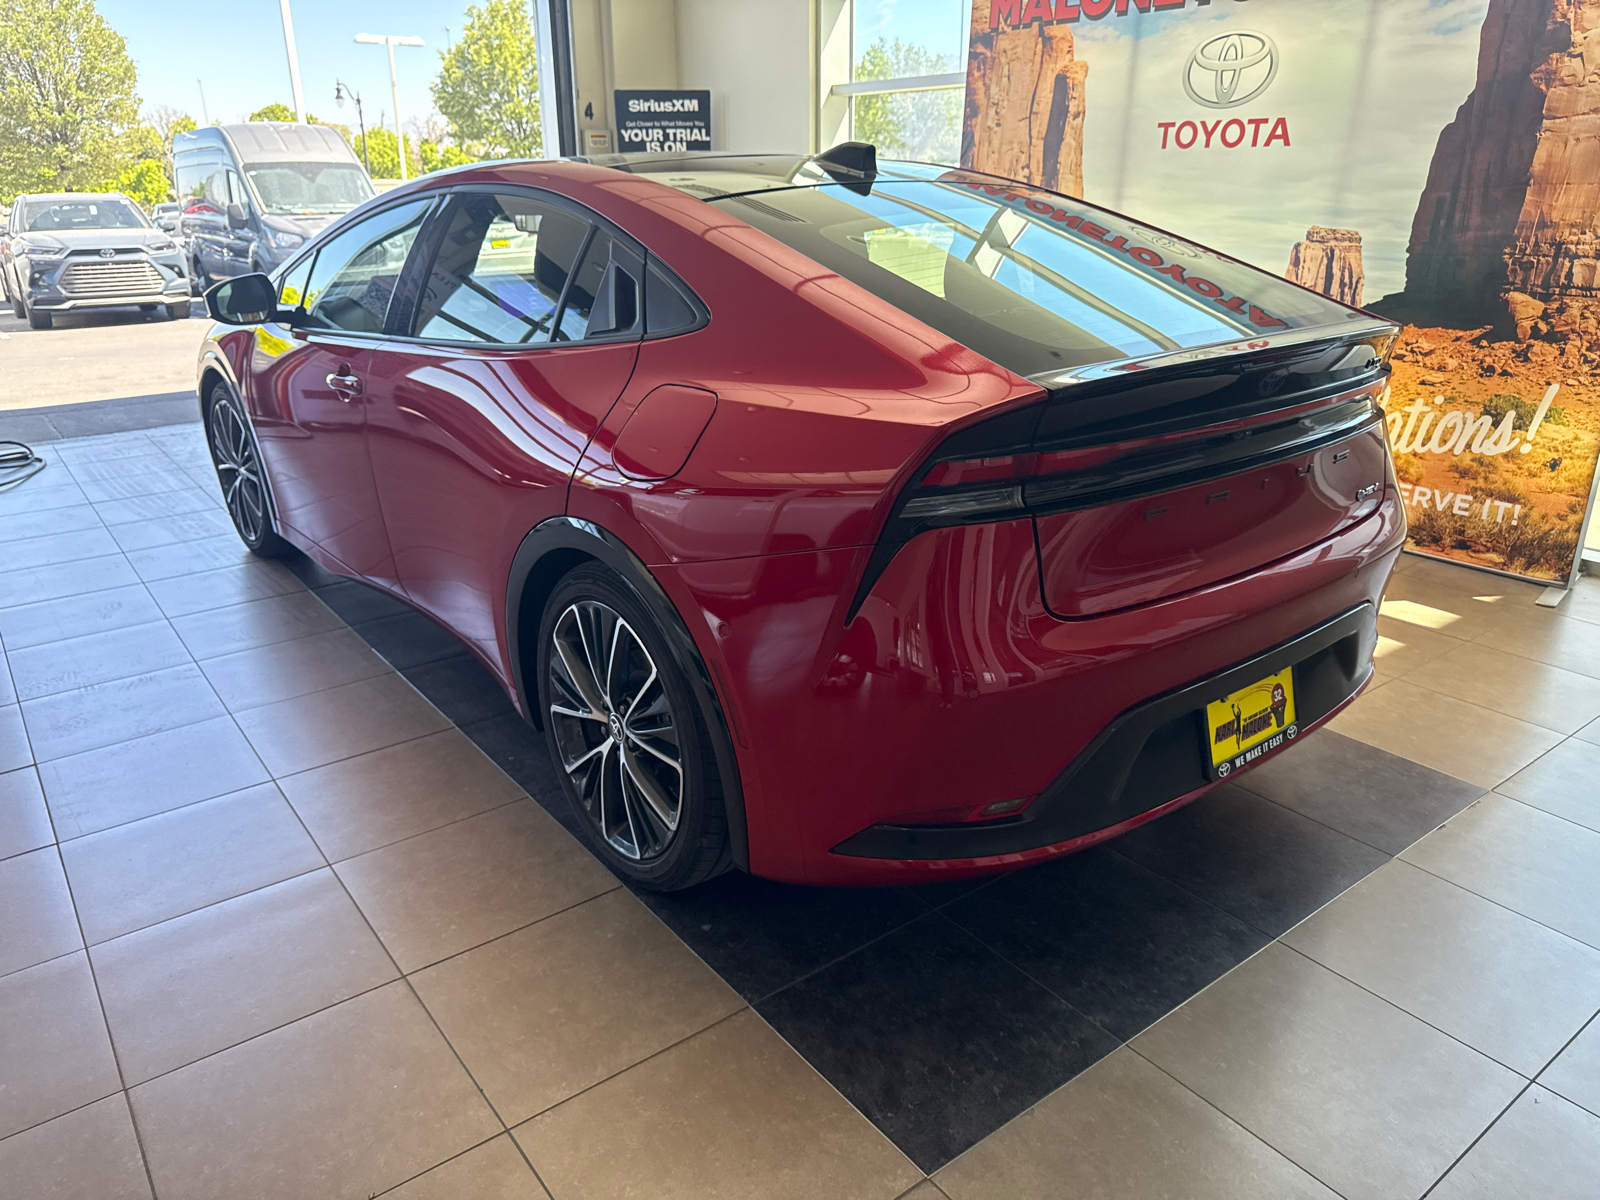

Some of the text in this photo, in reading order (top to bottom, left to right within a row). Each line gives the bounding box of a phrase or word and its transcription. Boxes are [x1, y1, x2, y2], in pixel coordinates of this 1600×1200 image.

[989, 0, 1186, 30] MALO
[585, 102, 594, 120] 4
[628, 99, 699, 113] SiriusXM
[626, 120, 636, 128] Get
[621, 128, 664, 142] YOUR
[666, 128, 711, 141] TRIAL
[1157, 117, 1291, 149] TOYOTA
[646, 142, 687, 153] IS ON
[1481, 499, 1522, 526] IT!
[1273, 689, 1283, 702] 32
[1234, 733, 1283, 768] WE MAKE IT EASY
